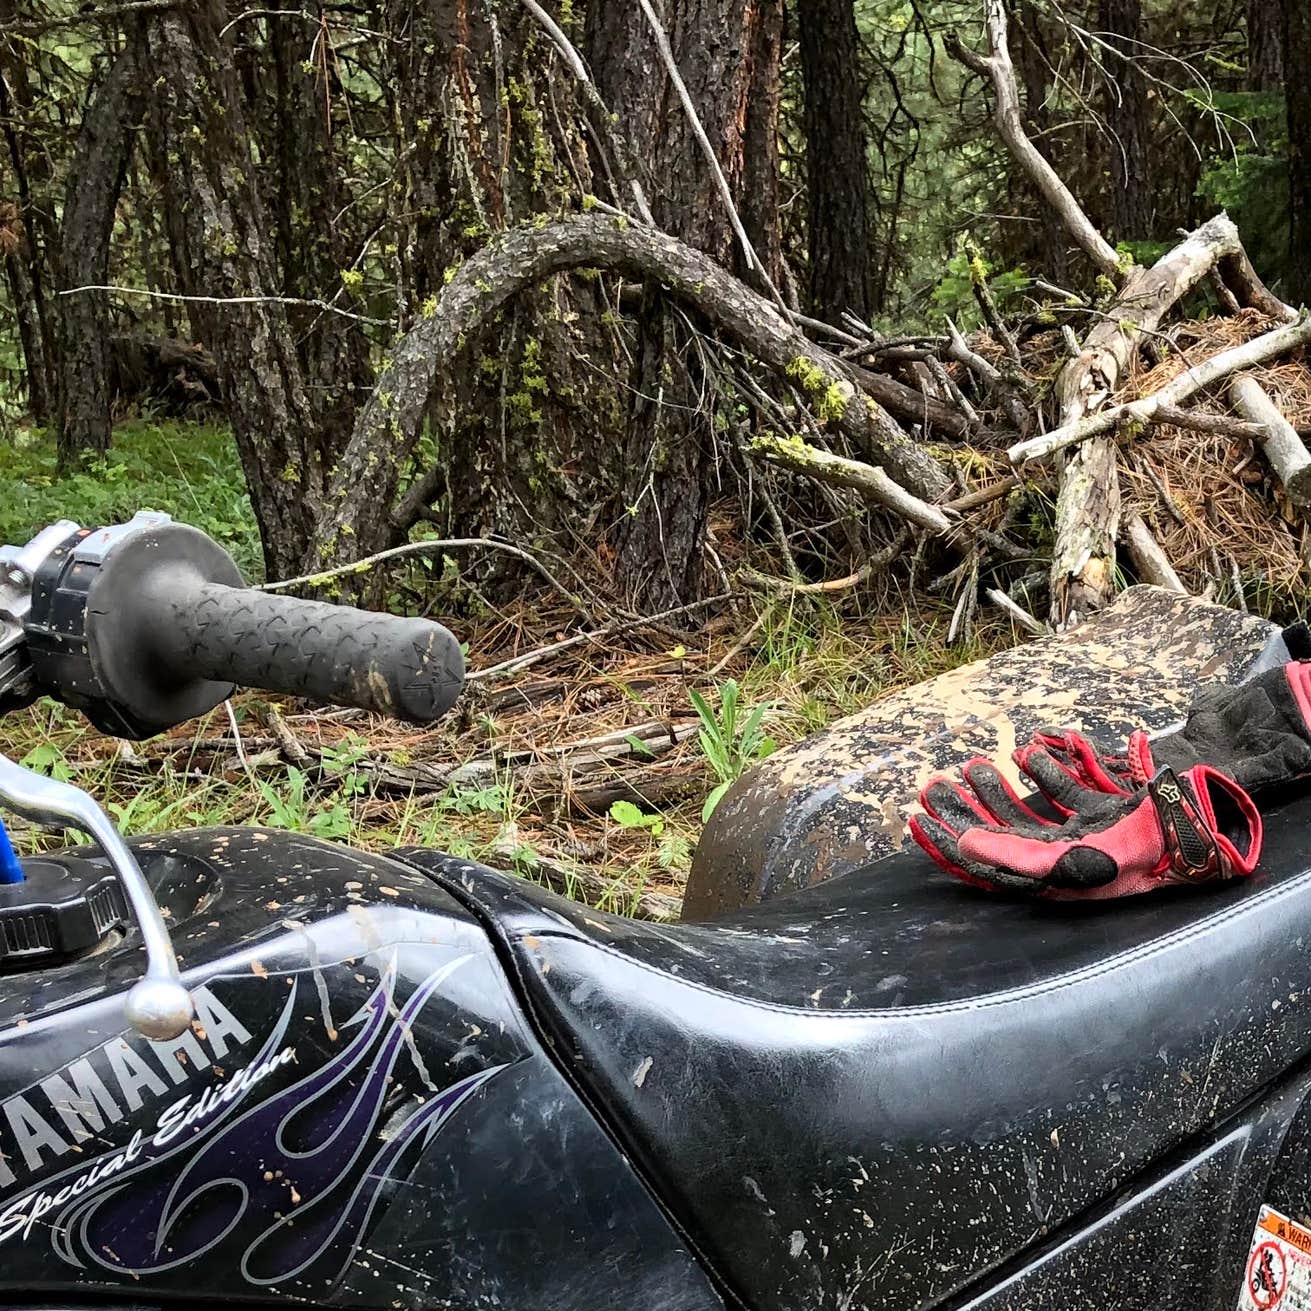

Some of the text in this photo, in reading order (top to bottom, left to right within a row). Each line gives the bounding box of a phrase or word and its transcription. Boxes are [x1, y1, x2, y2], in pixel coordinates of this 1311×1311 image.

[0, 985, 253, 1188] AMAHA
[0, 1047, 297, 1242] Special Edition
